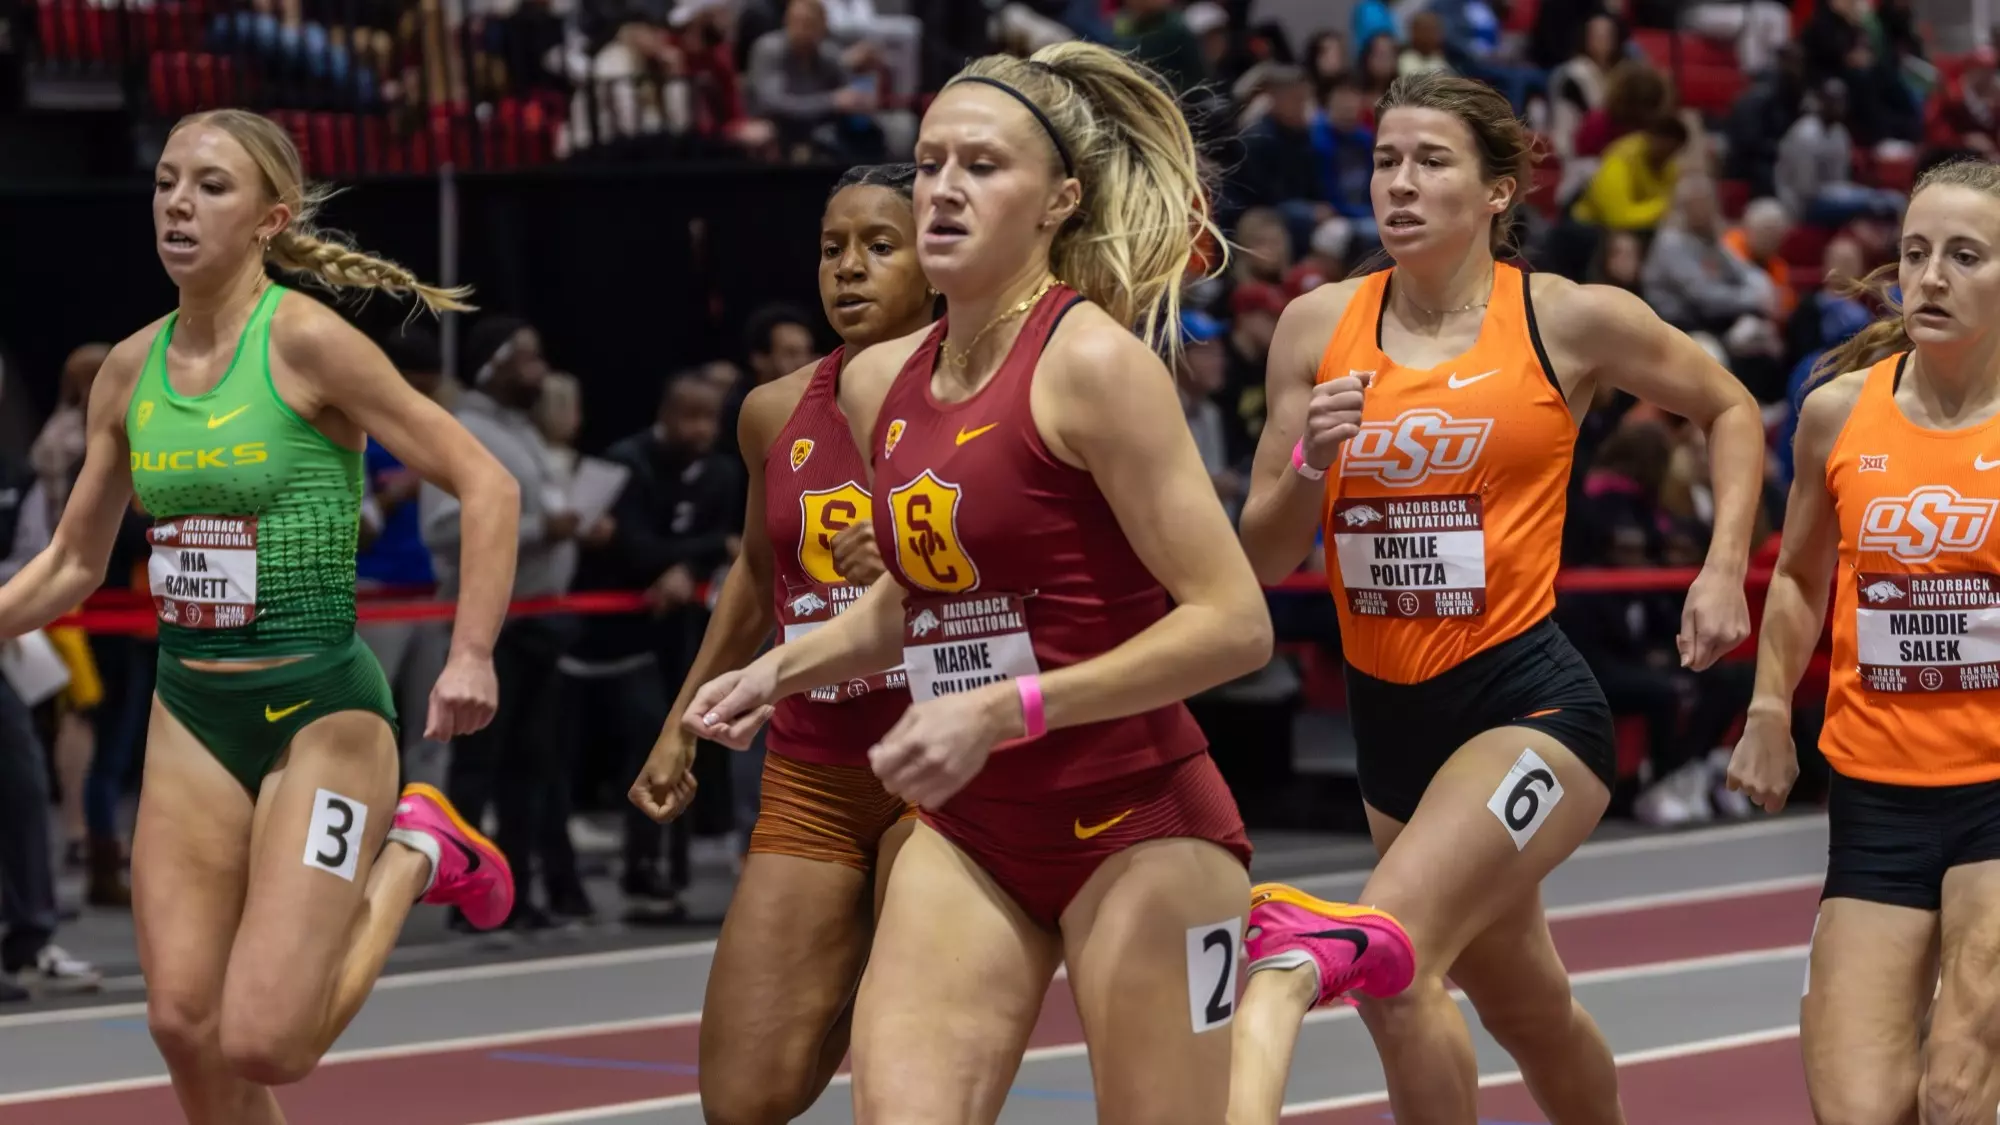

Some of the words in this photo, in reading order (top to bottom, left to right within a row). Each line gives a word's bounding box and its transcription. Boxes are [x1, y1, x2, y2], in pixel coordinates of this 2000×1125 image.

[131, 442, 268, 472] DUCKS
[1343, 412, 1488, 483] OSU
[1862, 457, 1885, 470] XII
[1388, 500, 1467, 515] RAZORBACK
[1389, 514, 1478, 529] INVITATIONAL
[1861, 489, 1993, 559] OSU
[181, 532, 253, 547] INVITATIONAL
[1374, 536, 1438, 559] KAYLIE
[180, 551, 208, 572] MIA
[1370, 563, 1446, 586] POLITZA
[1912, 578, 1990, 592] RAZORBACK
[1435, 591, 1472, 600] RANDAL
[1912, 592, 2000, 606] INVITATIONAL
[943, 596, 1009, 620] RAZORBACK
[1436, 606, 1472, 616] CENTER
[944, 612, 1023, 636] INVITATIONAL
[1889, 613, 1968, 635] MADDIE
[933, 642, 992, 675] MARNE
[1899, 640, 1962, 662] SALEK
[1872, 667, 1900, 676] TRACK
[1960, 664, 1997, 675] RANDAL
[1873, 682, 1902, 692] WORLD
[1962, 679, 1998, 689] CENTER
[1505, 768, 1554, 832] 6
[315, 798, 353, 868] 3
[1203, 928, 1232, 1024] 2
